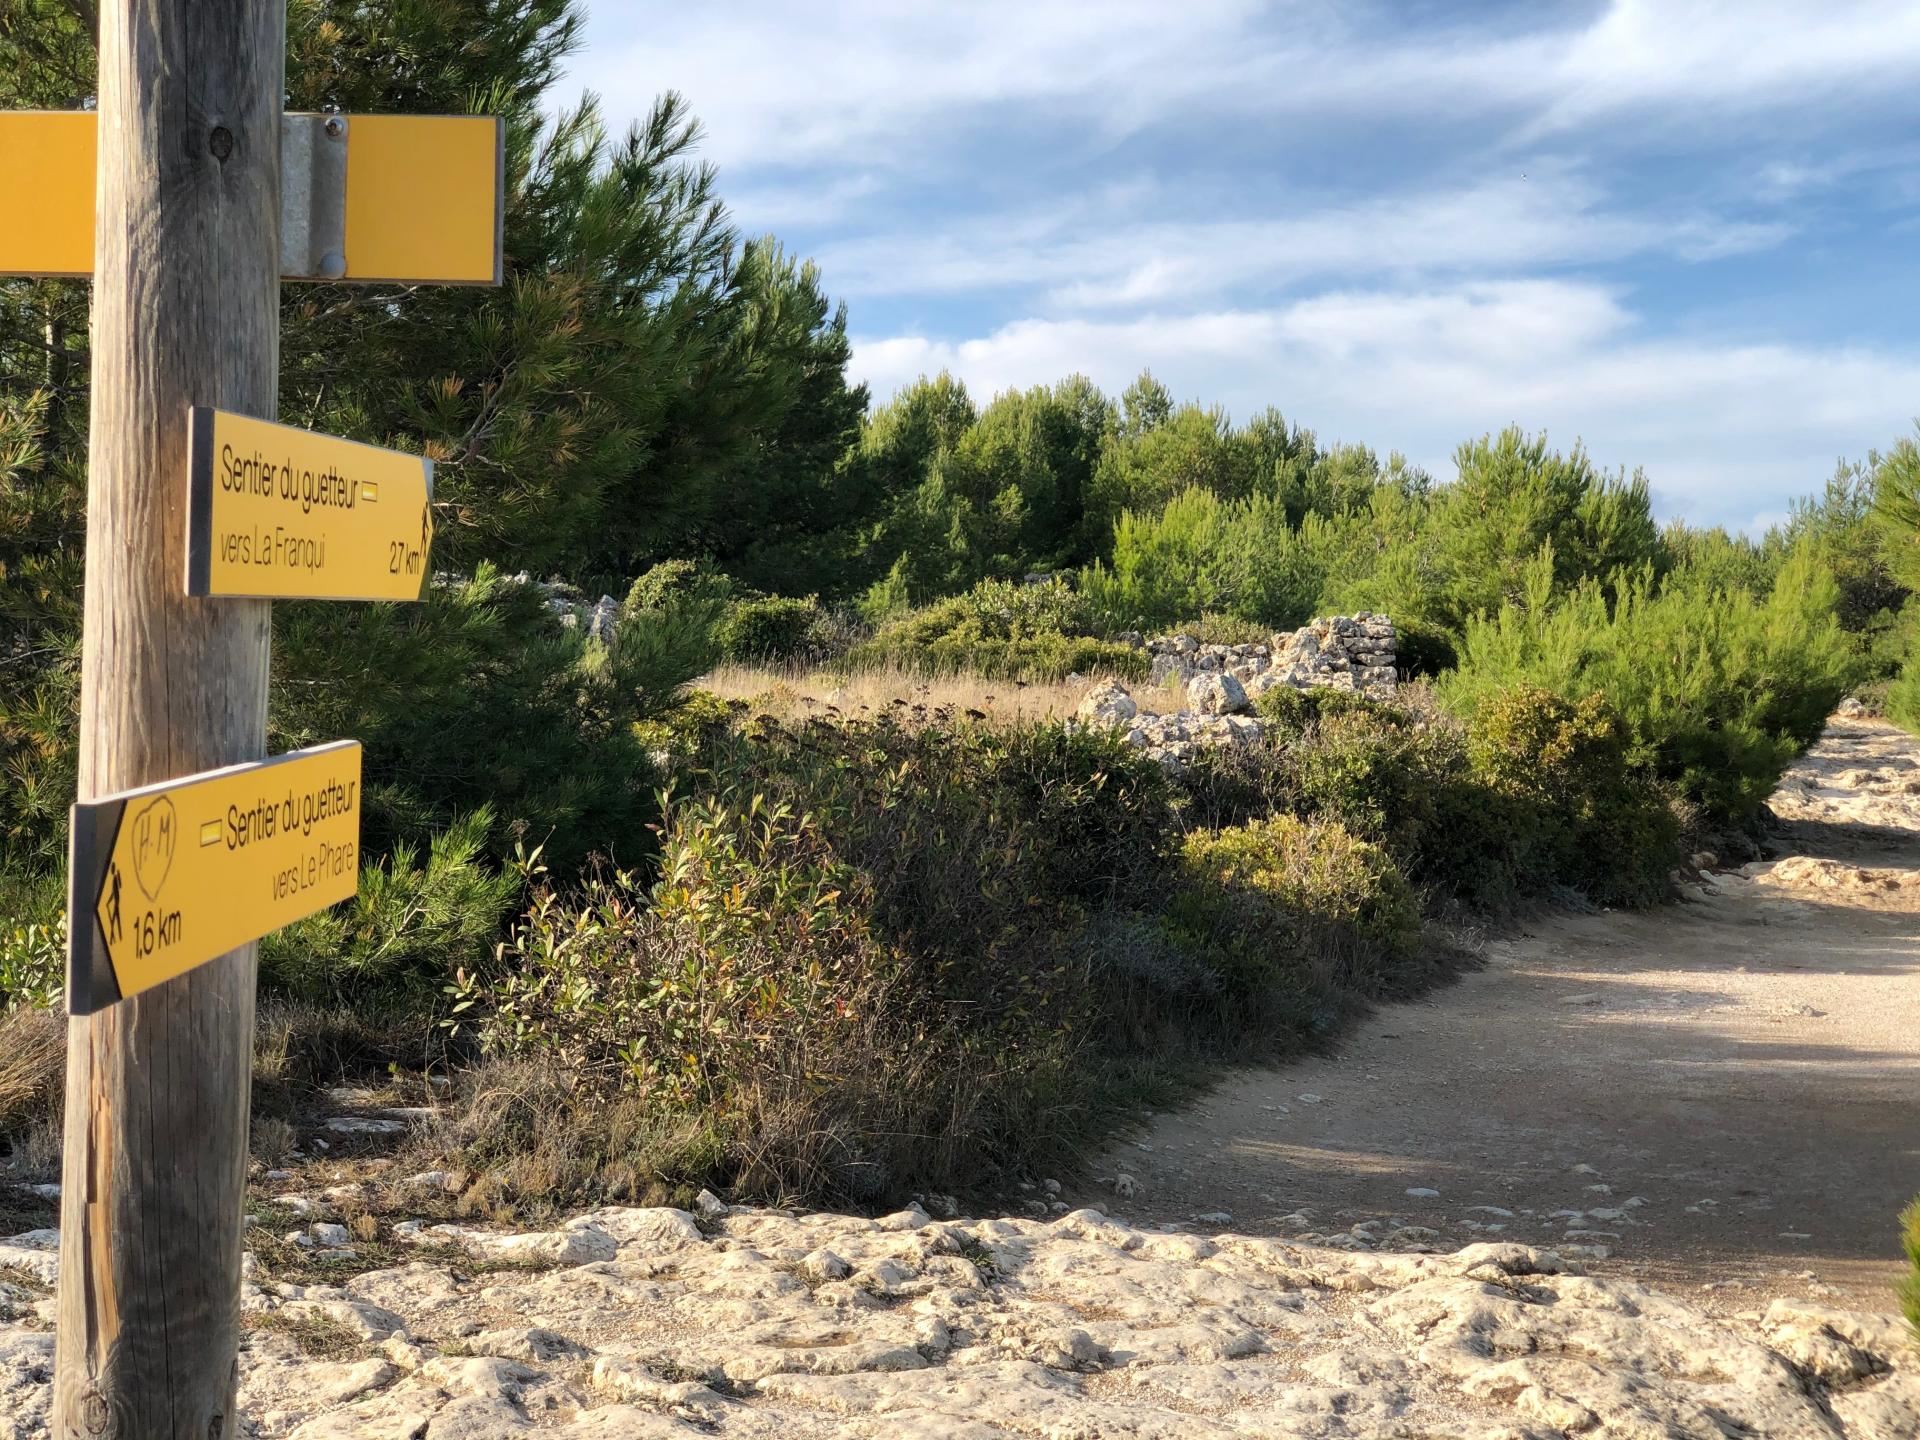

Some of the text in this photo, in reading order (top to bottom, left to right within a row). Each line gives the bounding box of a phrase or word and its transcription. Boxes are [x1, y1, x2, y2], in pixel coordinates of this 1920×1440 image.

[221, 443, 358, 514] Sentier du guetteur
[221, 524, 325, 575] vers La Franqui
[405, 543, 420, 575] km
[227, 777, 356, 851] Sentier du guetteur
[273, 842, 354, 901] vers Le Phare
[158, 908, 181, 949] km
